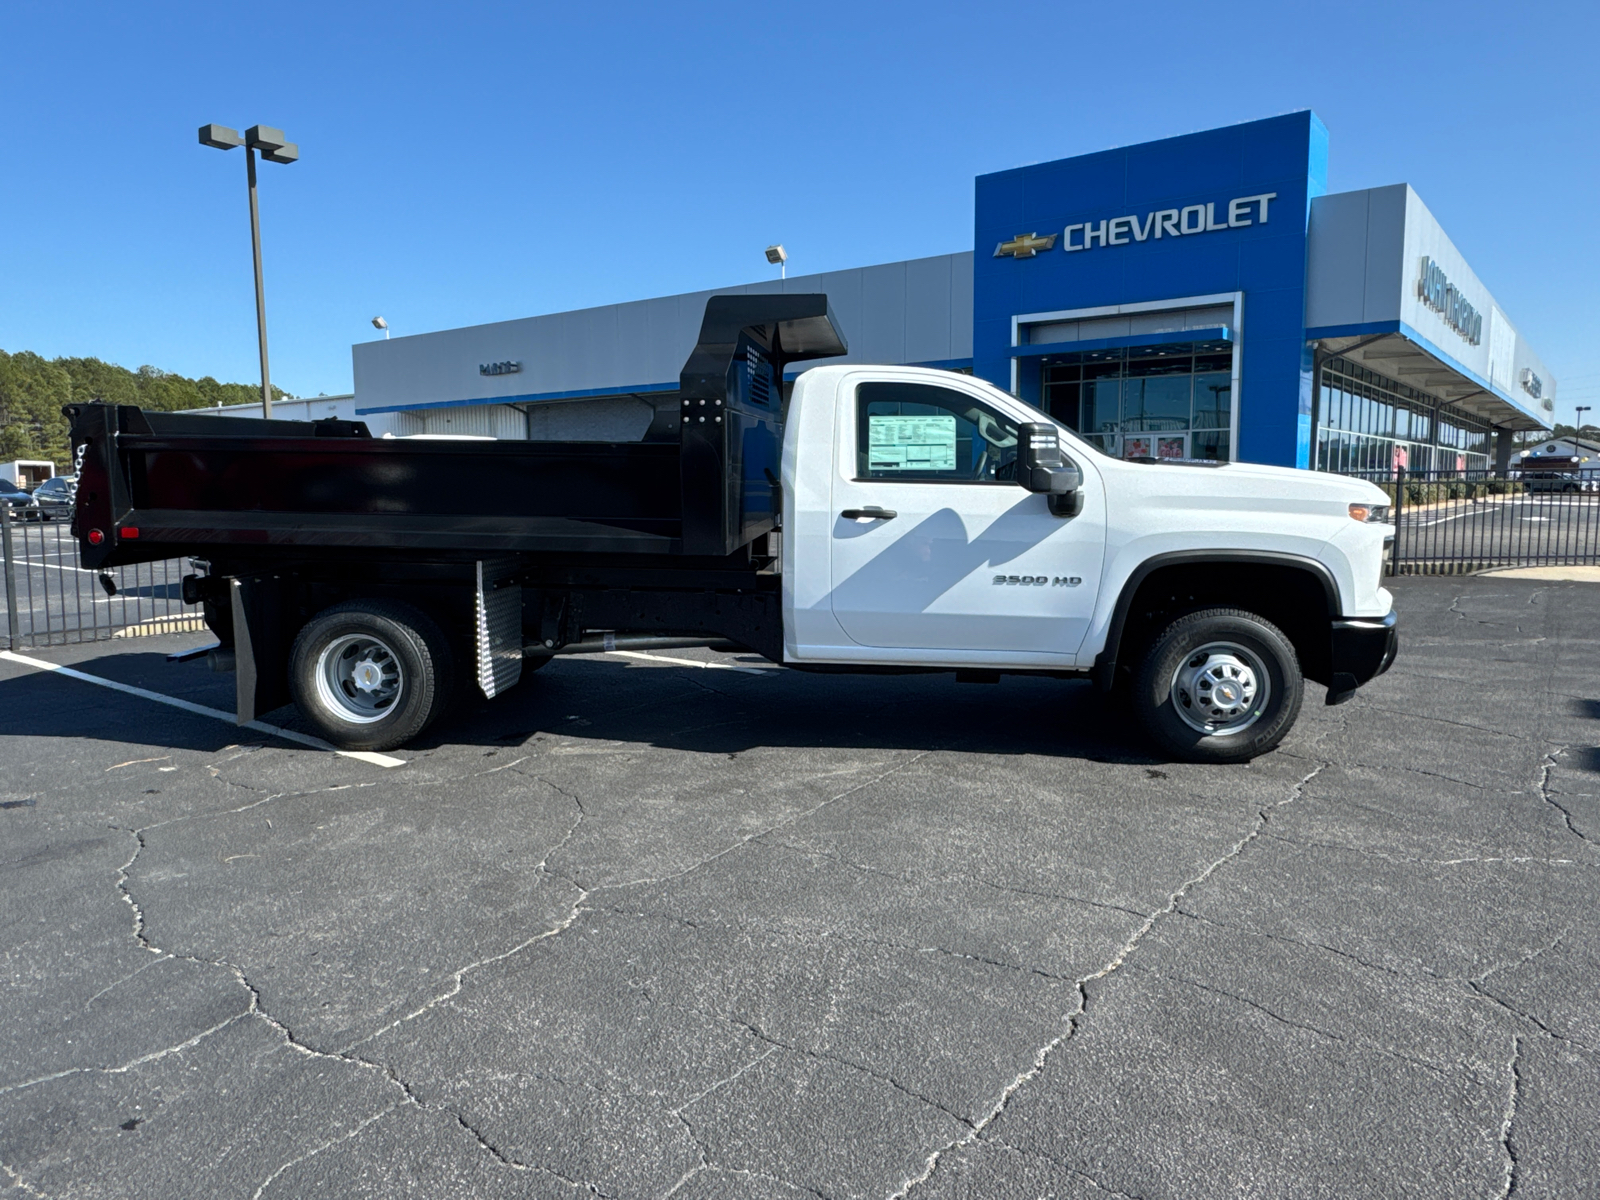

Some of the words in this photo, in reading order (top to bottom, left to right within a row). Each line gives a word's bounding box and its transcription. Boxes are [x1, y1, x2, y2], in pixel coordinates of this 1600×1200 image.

[1063, 192, 1278, 253] CHEVROLET
[993, 575, 1048, 584] 3500
[1054, 576, 1082, 585] HD
